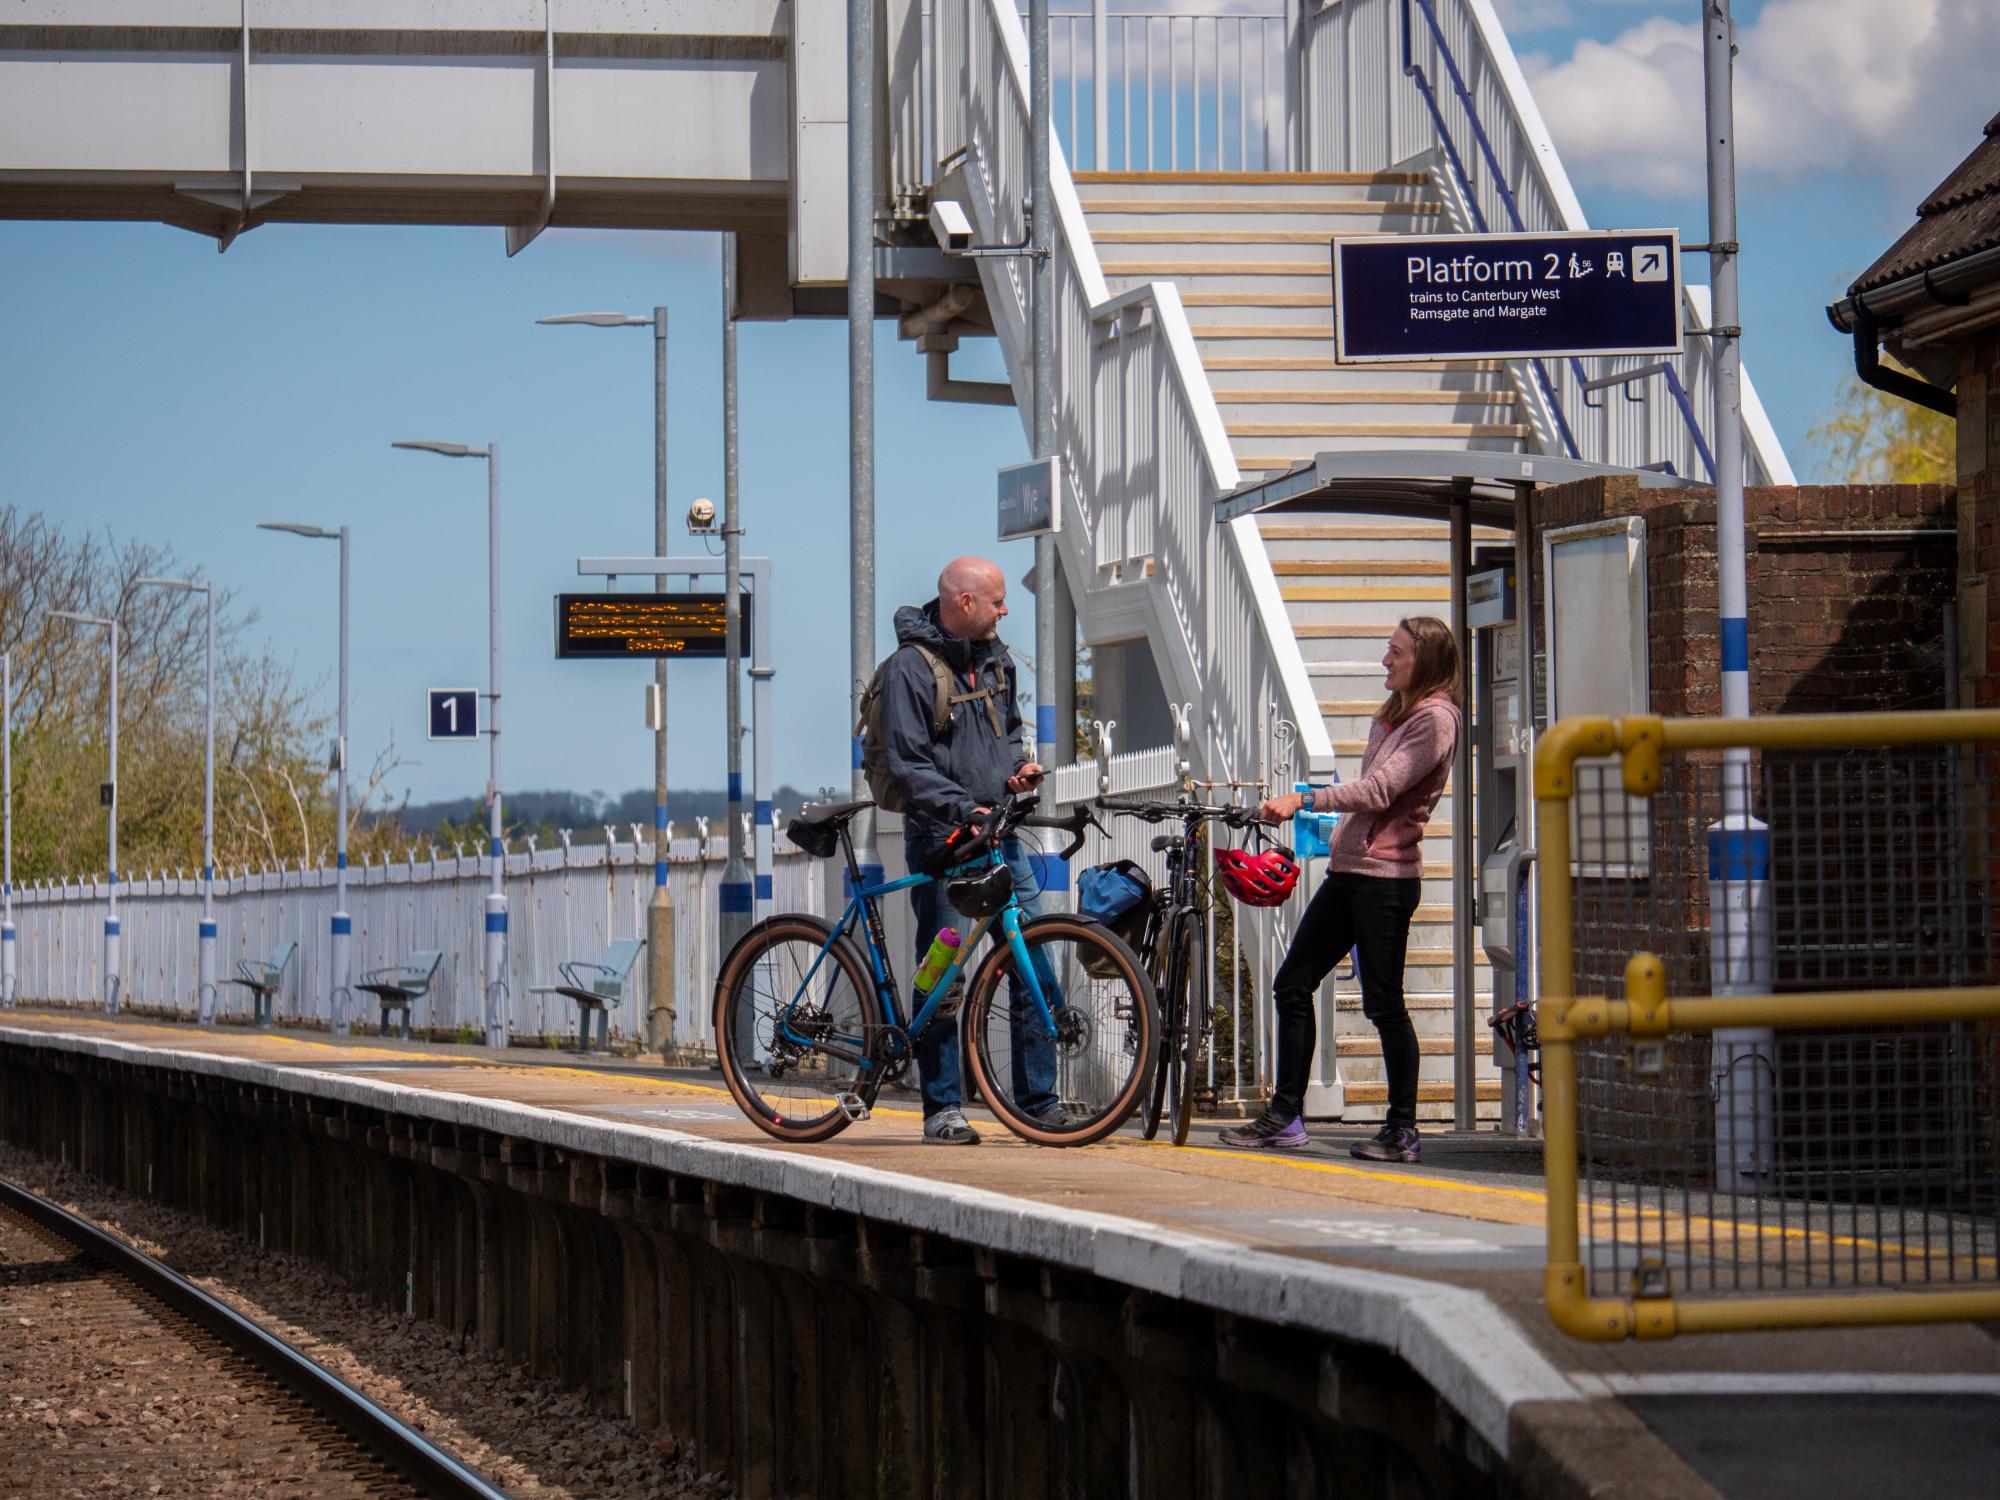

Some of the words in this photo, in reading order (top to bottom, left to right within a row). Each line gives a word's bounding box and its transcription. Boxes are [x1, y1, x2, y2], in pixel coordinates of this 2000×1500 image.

[1407, 255, 1533, 284] Platform
[1543, 253, 1561, 280] 2
[1409, 291, 1443, 304] trains
[1446, 292, 1459, 302] to
[1461, 289, 1528, 303] Canterbury
[1531, 288, 1561, 300] West
[1410, 307, 1470, 322] Ramsgate
[1472, 306, 1495, 318] and
[1498, 305, 1547, 319] Margate
[1022, 482, 1039, 524] Wye
[441, 696, 457, 732] 1
